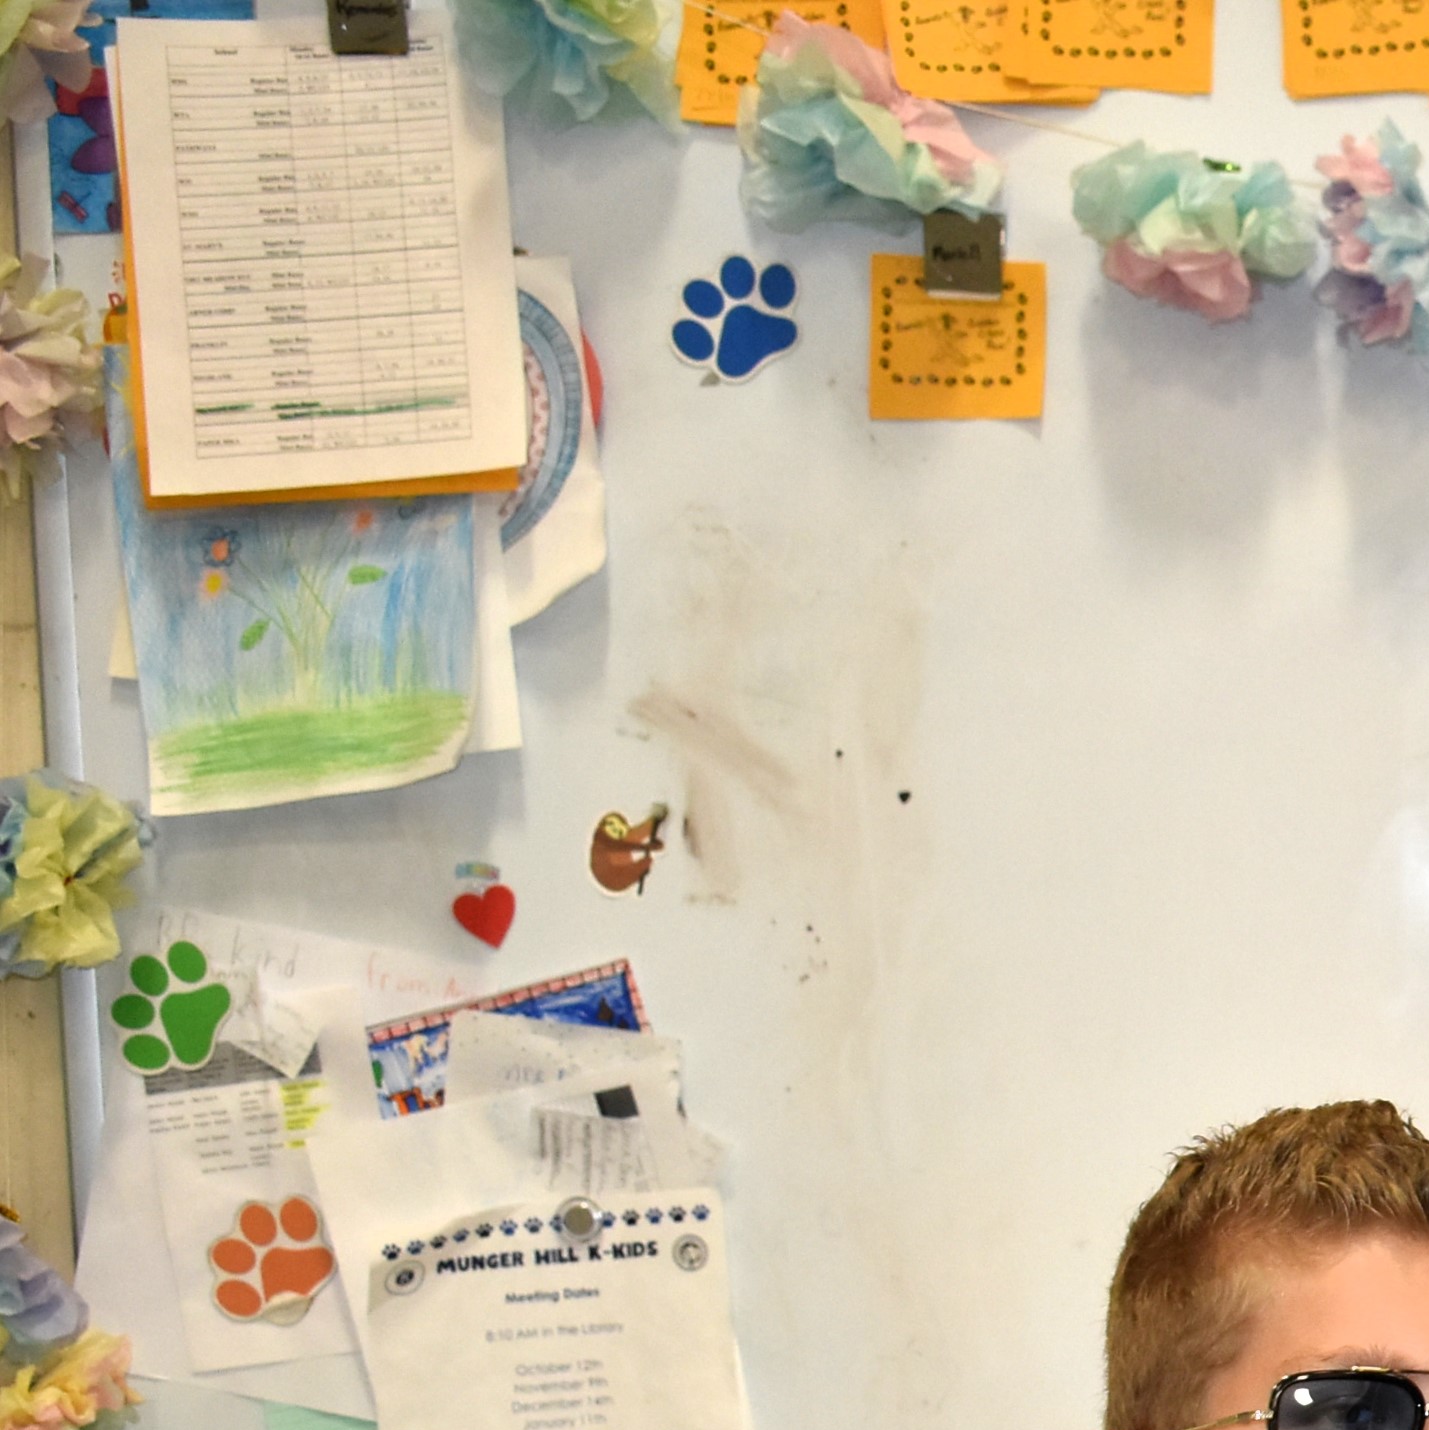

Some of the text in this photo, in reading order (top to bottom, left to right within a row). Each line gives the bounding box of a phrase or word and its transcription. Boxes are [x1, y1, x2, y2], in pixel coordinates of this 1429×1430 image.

[436, 1241, 660, 1274] MUNGER HILL K-KIDS
[504, 1286, 600, 1305] Meeting Dates
[581, 1321, 624, 1336] Library
[515, 1360, 573, 1378] October
[513, 1377, 584, 1394] November
[511, 1396, 584, 1413] December
